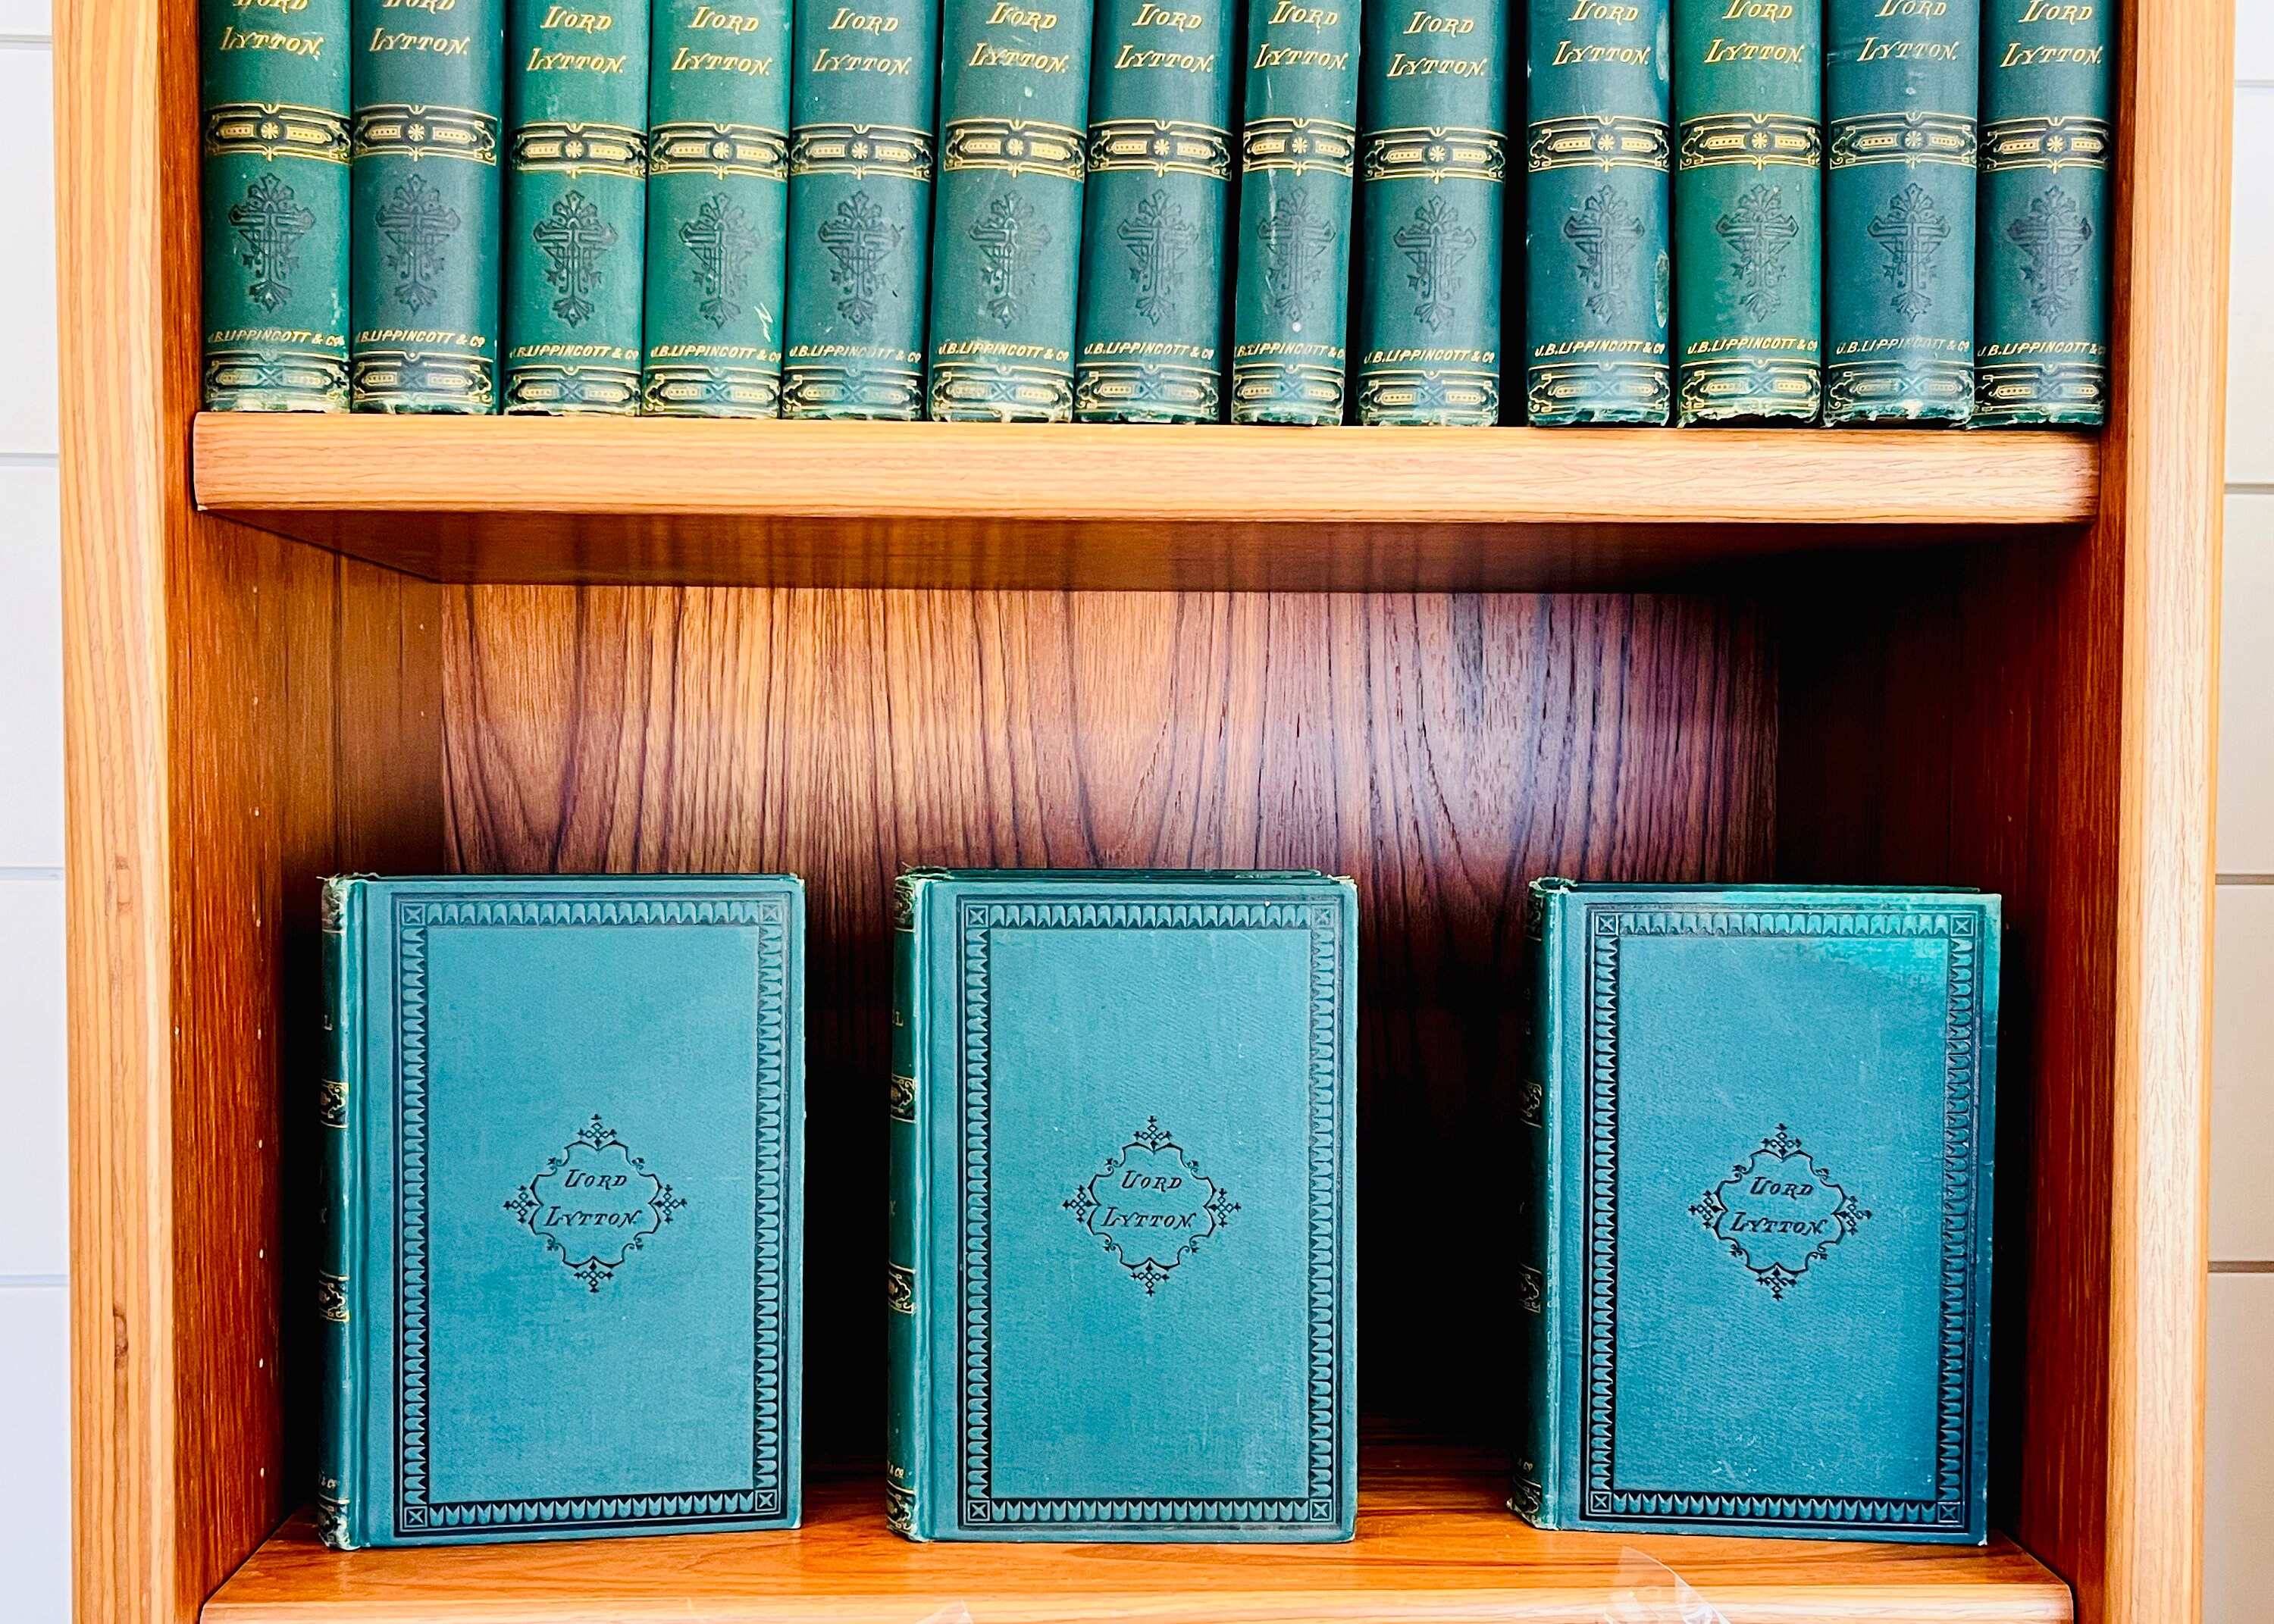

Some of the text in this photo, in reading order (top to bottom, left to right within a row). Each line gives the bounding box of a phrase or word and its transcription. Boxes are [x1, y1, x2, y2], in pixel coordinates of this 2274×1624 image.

[540, 6, 612, 33] LORD
[986, 2, 1057, 32] LORD
[1132, 4, 1201, 32] LORD
[1268, 1, 1339, 29] LORD
[1568, 0, 1638, 25] LORD
[1722, 0, 1792, 23] LORD
[1875, 0, 1947, 20] LORD
[2019, 0, 2092, 25] LORD
[688, 6, 759, 35] LORD
[828, 8, 898, 36] LORD
[1403, 11, 1474, 37] LORD
[312, 333, 323, 344] &
[456, 334, 467, 346] &
[1643, 342, 1652, 353] &
[1796, 339, 1806, 351] &
[1947, 340, 1957, 351] &
[612, 348, 622, 359] &
[756, 349, 767, 361] &
[895, 350, 905, 361] &
[1043, 348, 1054, 360] &
[1189, 346, 1200, 358] &
[1328, 346, 1337, 358] &
[1471, 350, 1480, 362] &
[565, 1169, 628, 1190] LORD
[1122, 1170, 1182, 1192] LORD
[1749, 1176, 1814, 1200] LORD
